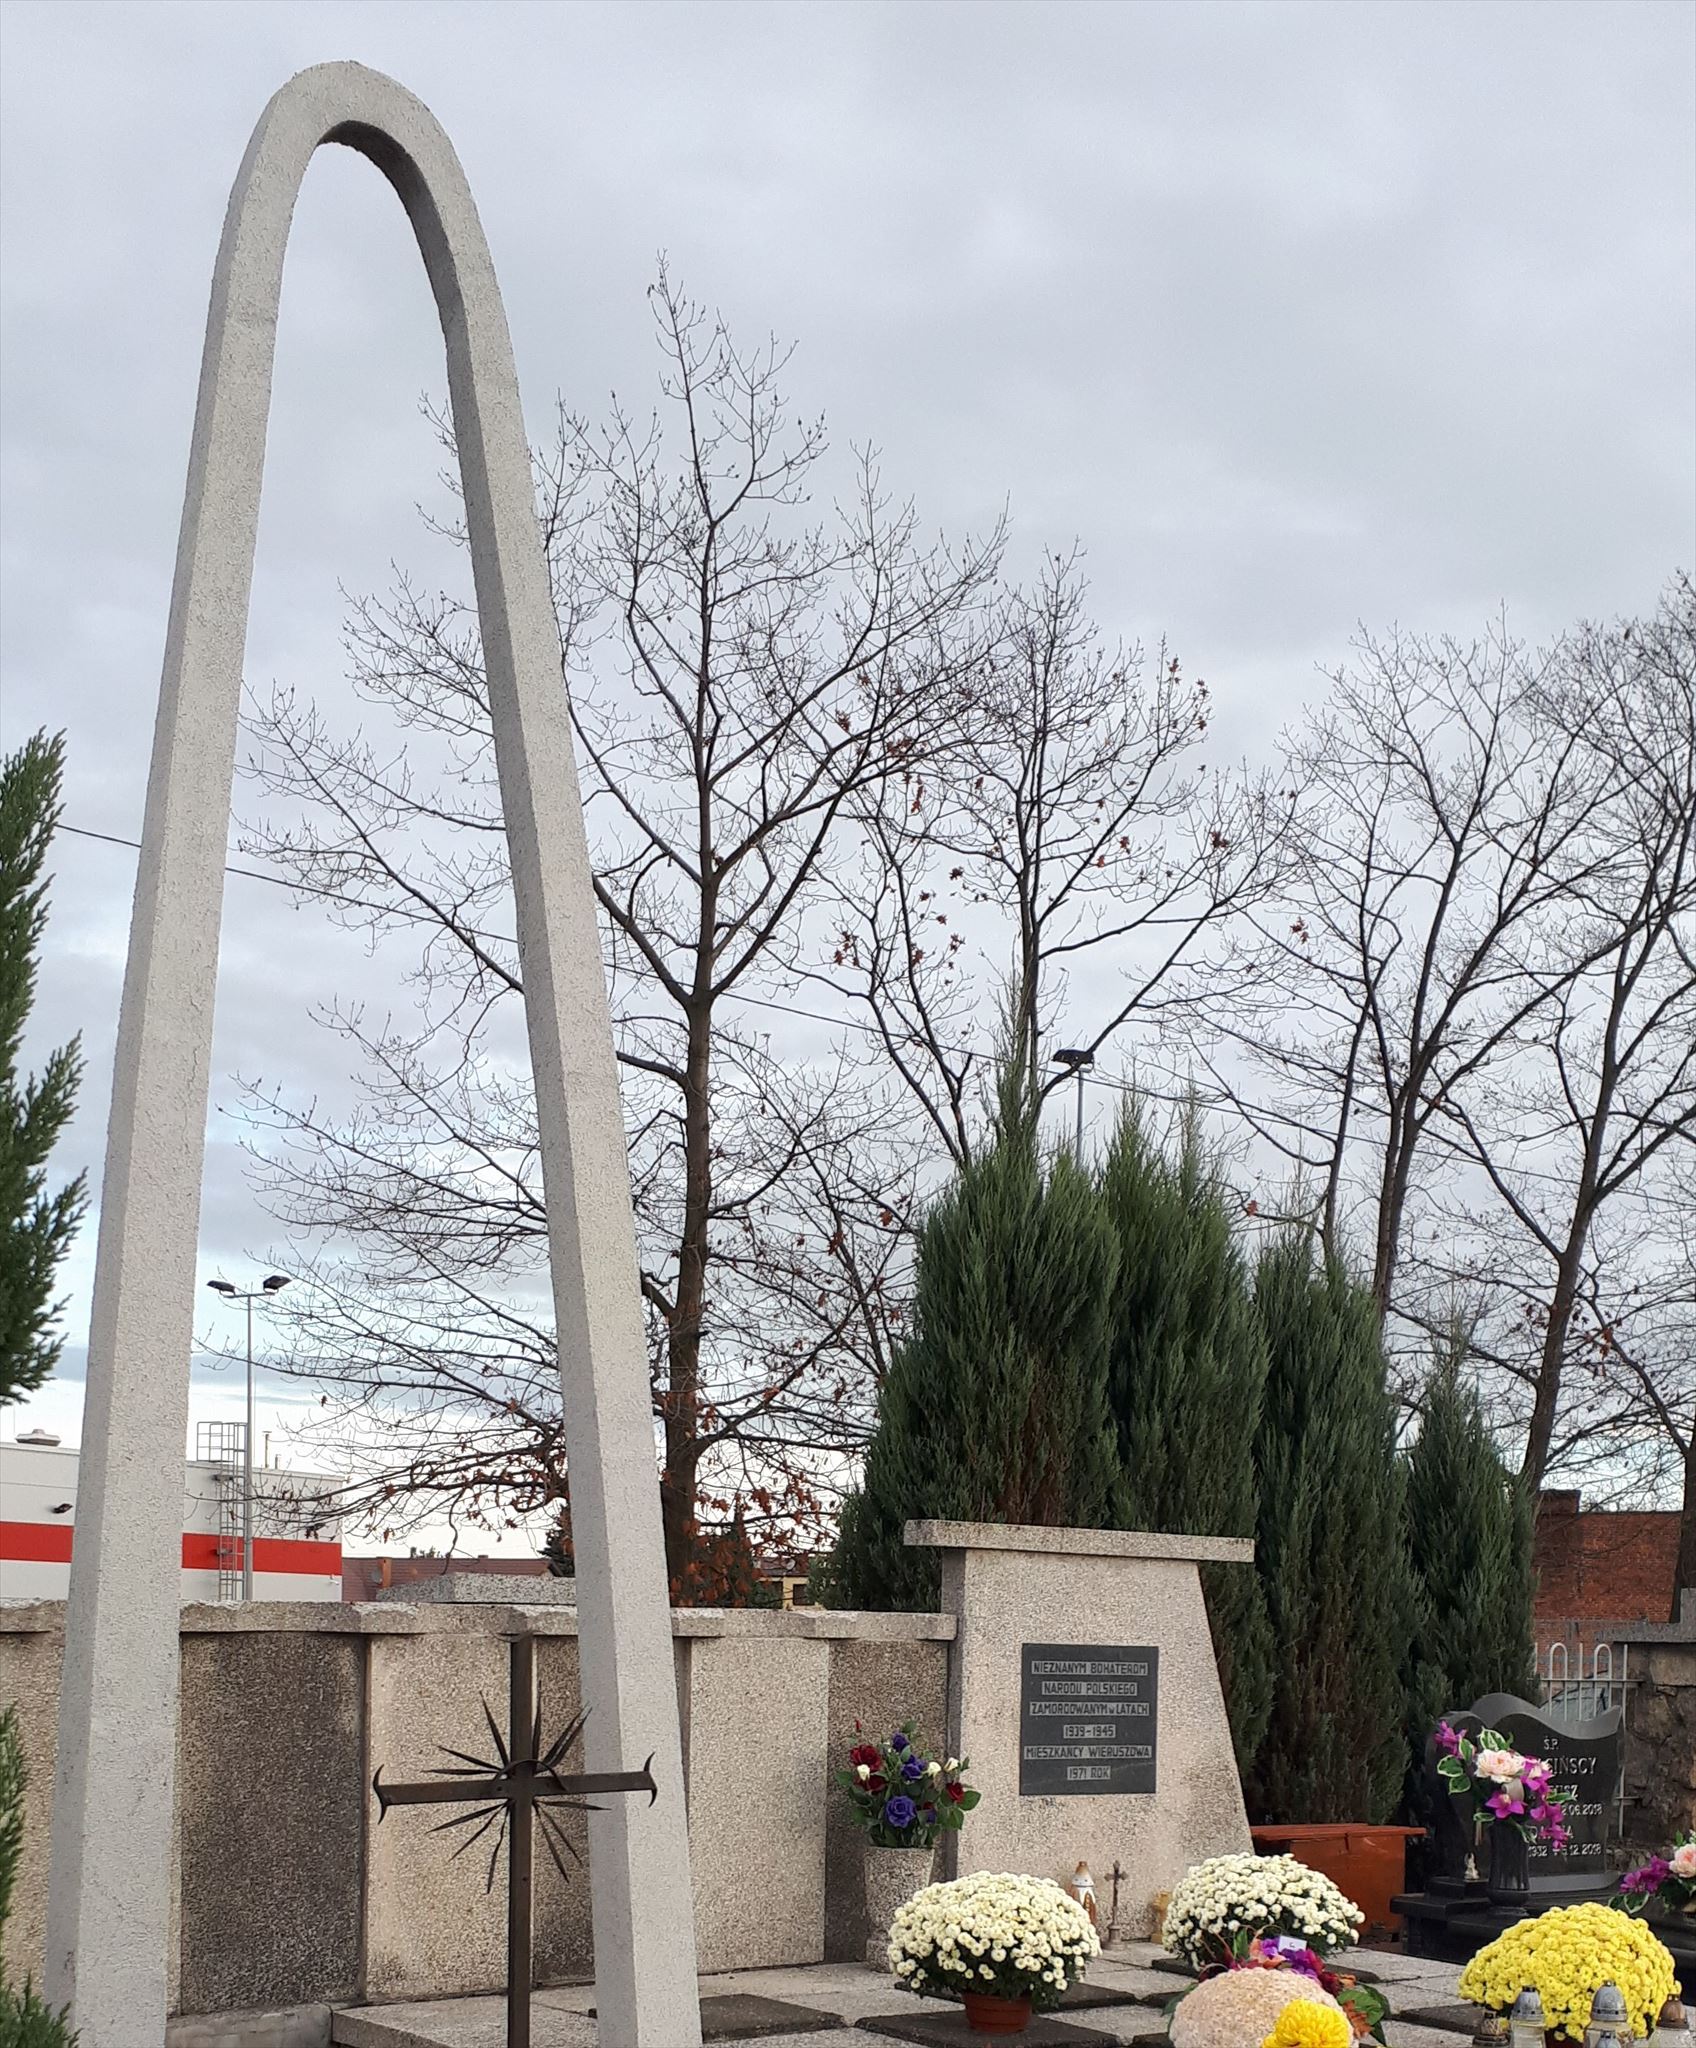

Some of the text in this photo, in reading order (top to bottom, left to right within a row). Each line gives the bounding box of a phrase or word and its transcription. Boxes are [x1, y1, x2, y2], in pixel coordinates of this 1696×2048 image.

[1034, 1662, 1146, 1675] NIEZNANYM BOHATEROM
[1044, 1682, 1136, 1695] NARODU POLSKIEGO
[1031, 1702, 1108, 1715] ZAMORDOWANYM
[1116, 1703, 1148, 1715] LATACH
[1065, 1725, 1114, 1737] 1939-1945
[1088, 1746, 1150, 1757] WIERUSZOWA
[1069, 1767, 1110, 1779] 1971 ROK
